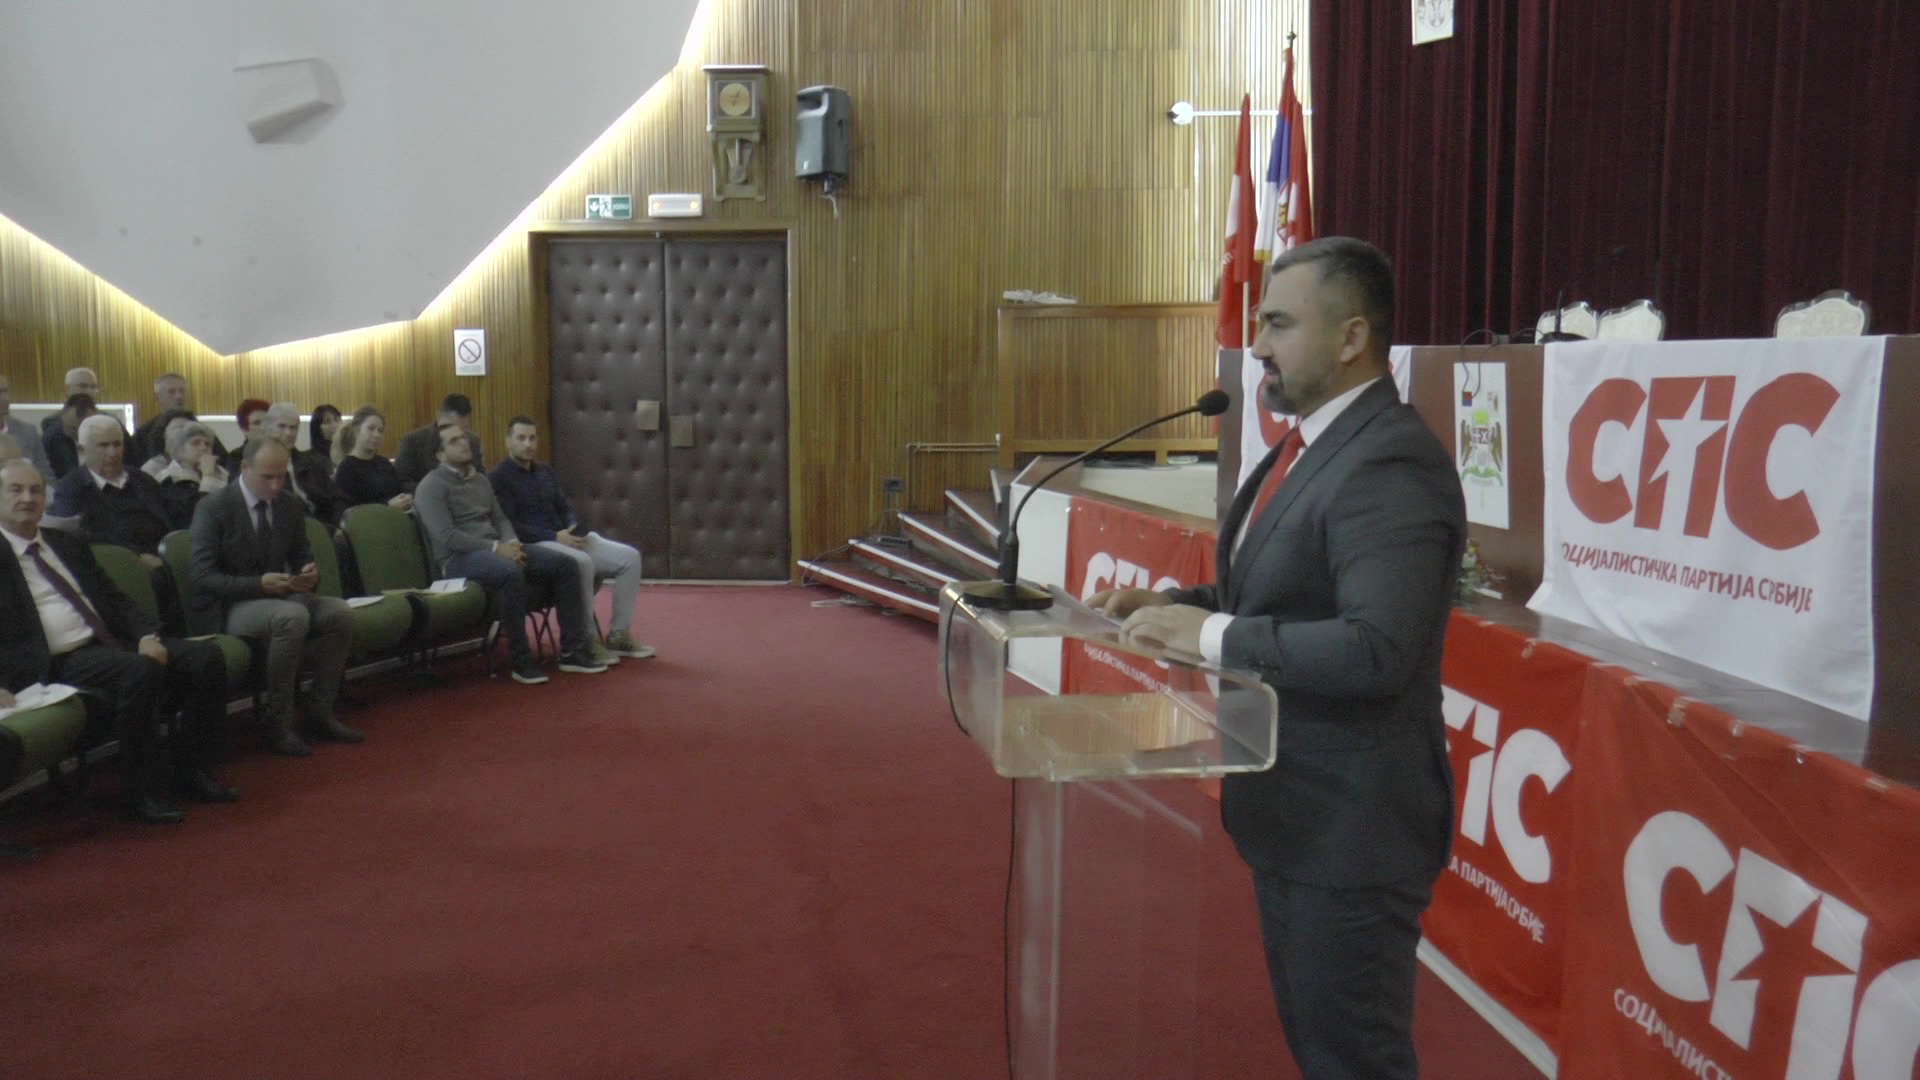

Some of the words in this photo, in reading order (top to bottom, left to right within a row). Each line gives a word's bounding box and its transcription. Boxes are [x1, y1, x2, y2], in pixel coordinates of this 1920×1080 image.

[1566, 372, 1841, 550] СПС
[1561, 542, 1677, 584] ОЦИЈАЛИСТИЧКА
[1680, 565, 1755, 600] ПАРТИЈА
[1758, 577, 1814, 614] СРБИЈЕ
[1442, 684, 1572, 884] ПС
[1460, 860, 1508, 911] ПАРТИЈА
